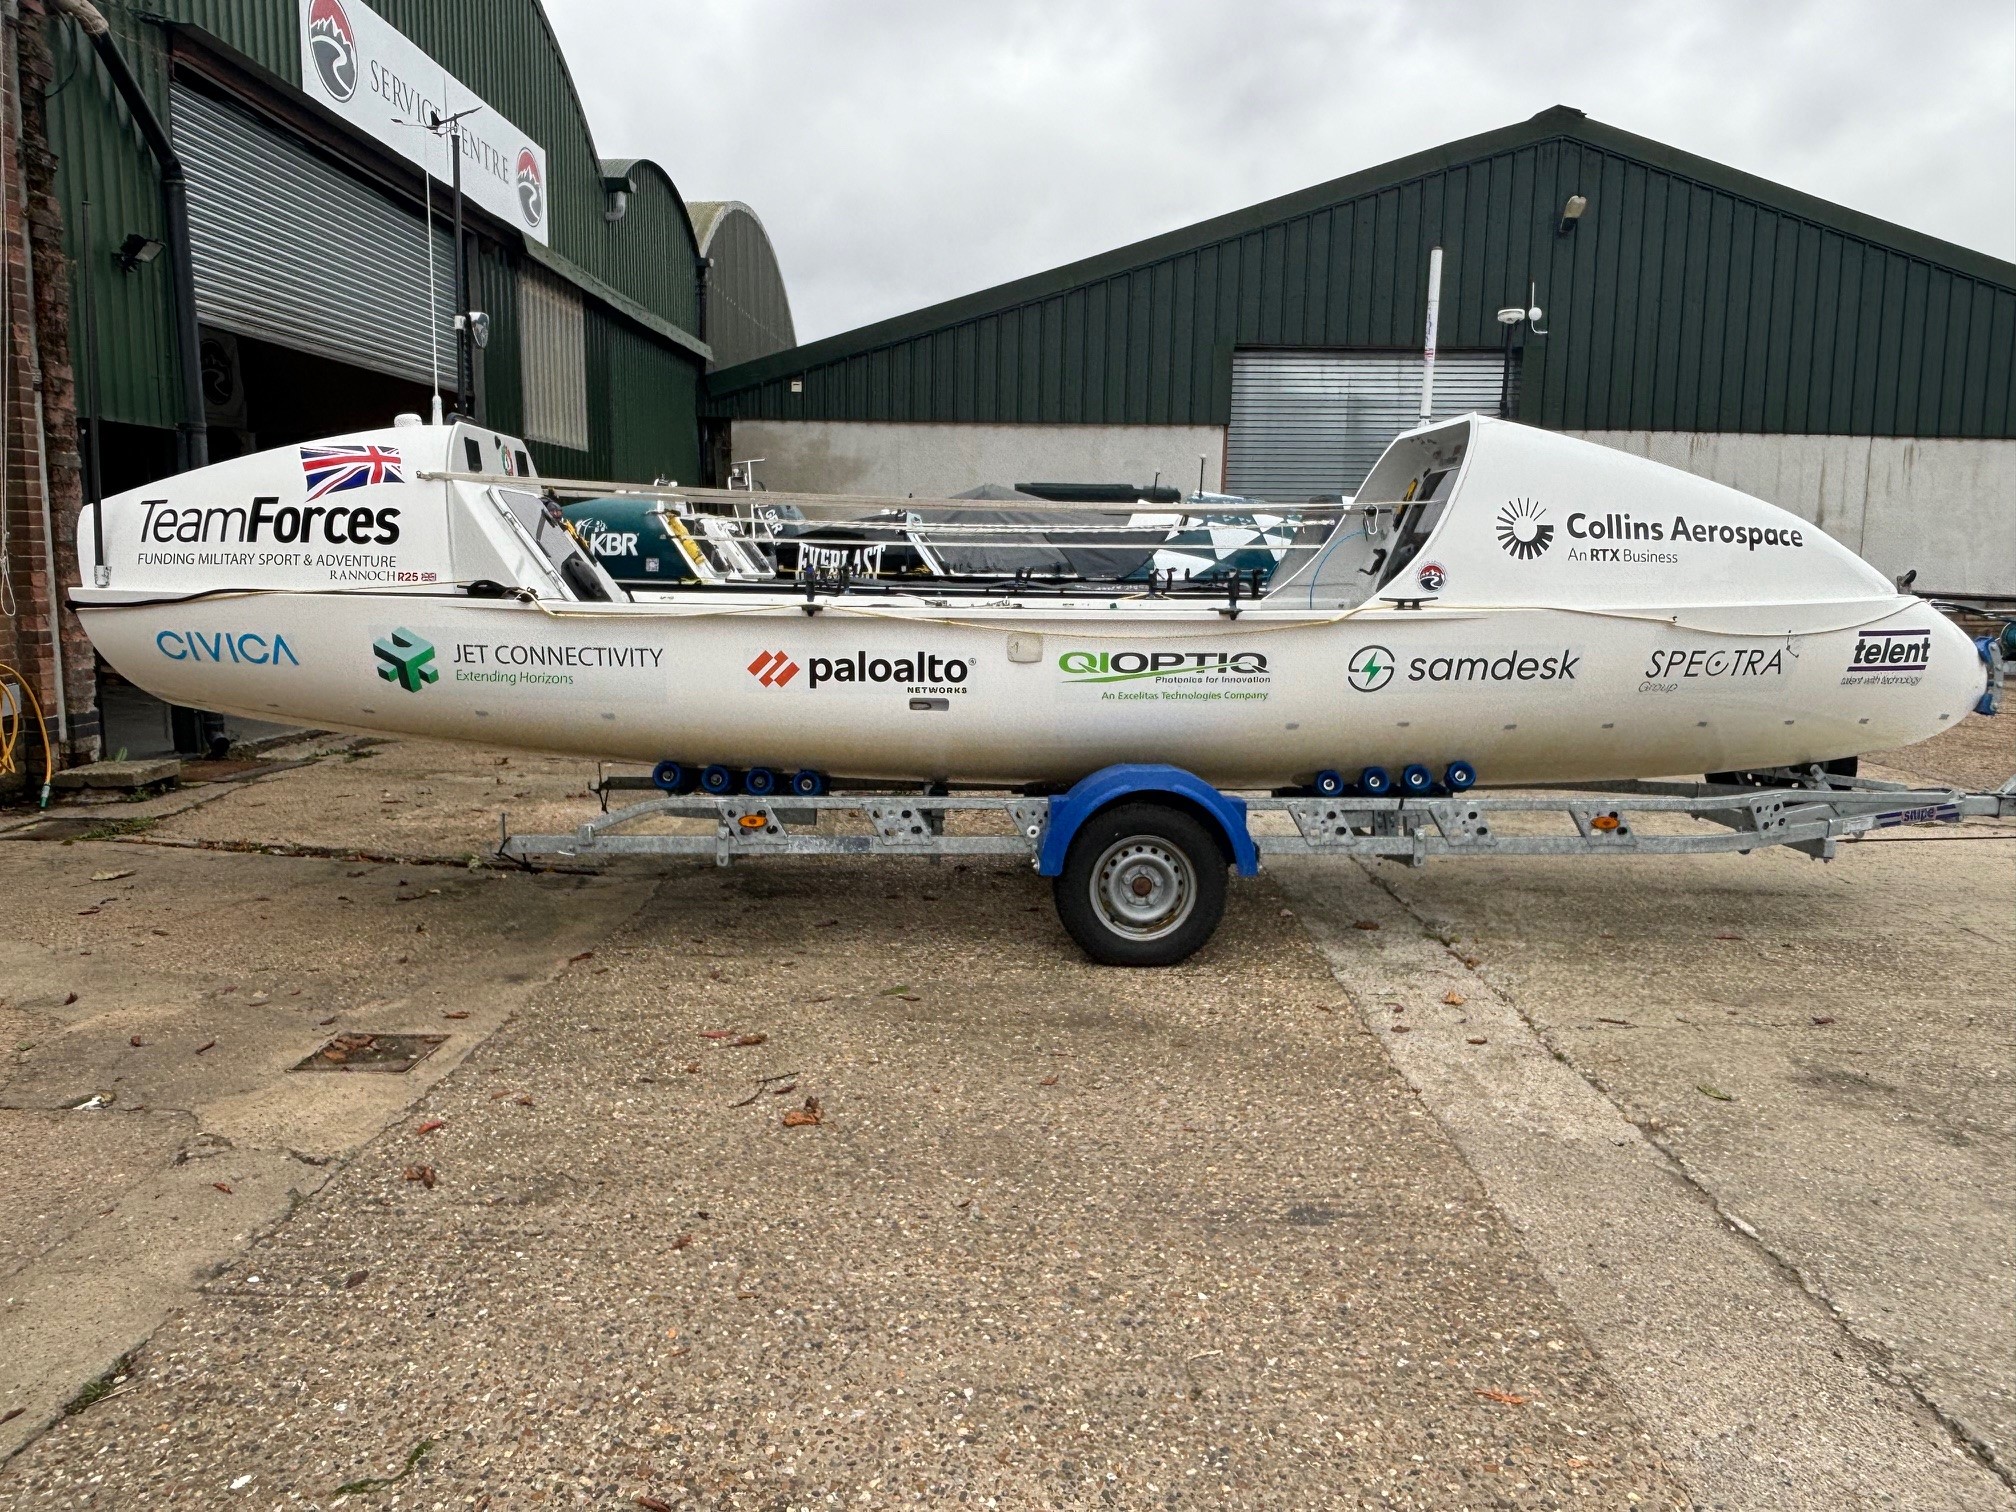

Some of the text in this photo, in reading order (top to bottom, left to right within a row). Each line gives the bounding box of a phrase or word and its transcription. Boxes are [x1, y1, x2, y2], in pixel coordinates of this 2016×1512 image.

[140, 497, 400, 545] TeamForces
[1566, 513, 1804, 551] Collins Aerospace
[590, 533, 638, 556] KBR
[1567, 548, 1678, 563] An RTX Business
[137, 553, 397, 568] FUNDING MILITARY SPORT & ADVENTURE
[329, 570, 419, 582] RANNOCH R25
[156, 630, 299, 666] CIVICA
[453, 644, 663, 668] JET CONNECTIVITY
[1853, 636, 1931, 664] telent
[808, 651, 968, 689] paloalto
[1058, 651, 1270, 674] QIOPTIQ
[1407, 649, 1580, 681] samdesk
[1645, 649, 1783, 679] SPECTRA
[455, 669, 574, 686] Extending Horizons
[1155, 676, 1271, 684] Photonics for Innovation
[907, 686, 968, 694] NETWORKS
[1101, 691, 1269, 701] An Excelitas Technologies Company
